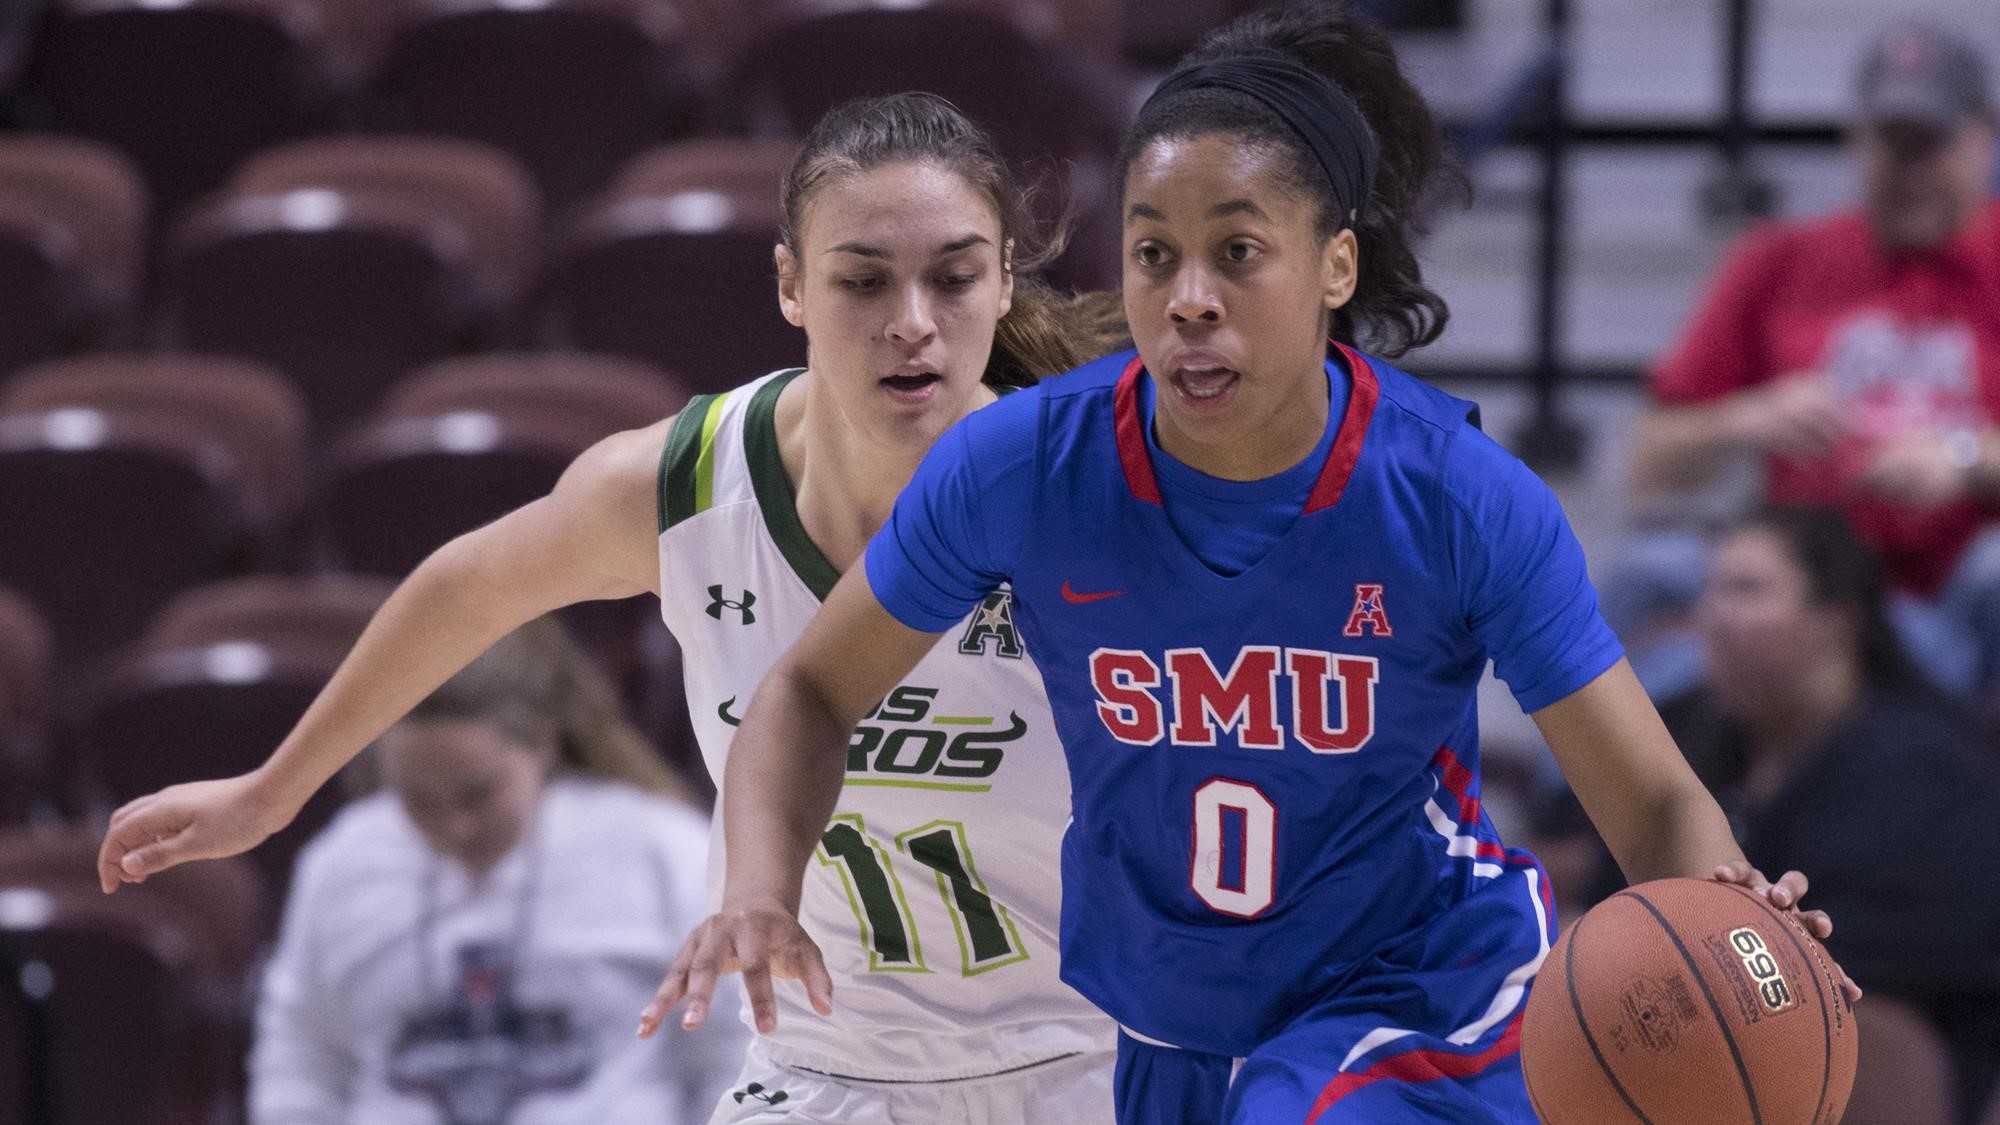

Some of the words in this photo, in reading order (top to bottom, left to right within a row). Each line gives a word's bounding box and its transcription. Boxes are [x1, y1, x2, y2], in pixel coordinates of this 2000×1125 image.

[1342, 583, 1393, 637] A
[846, 710, 1028, 778] ROS
[1089, 645, 1379, 754] SMU
[815, 813, 1030, 977] 11
[1189, 776, 1278, 920] 0
[1729, 927, 1792, 1011] 695
